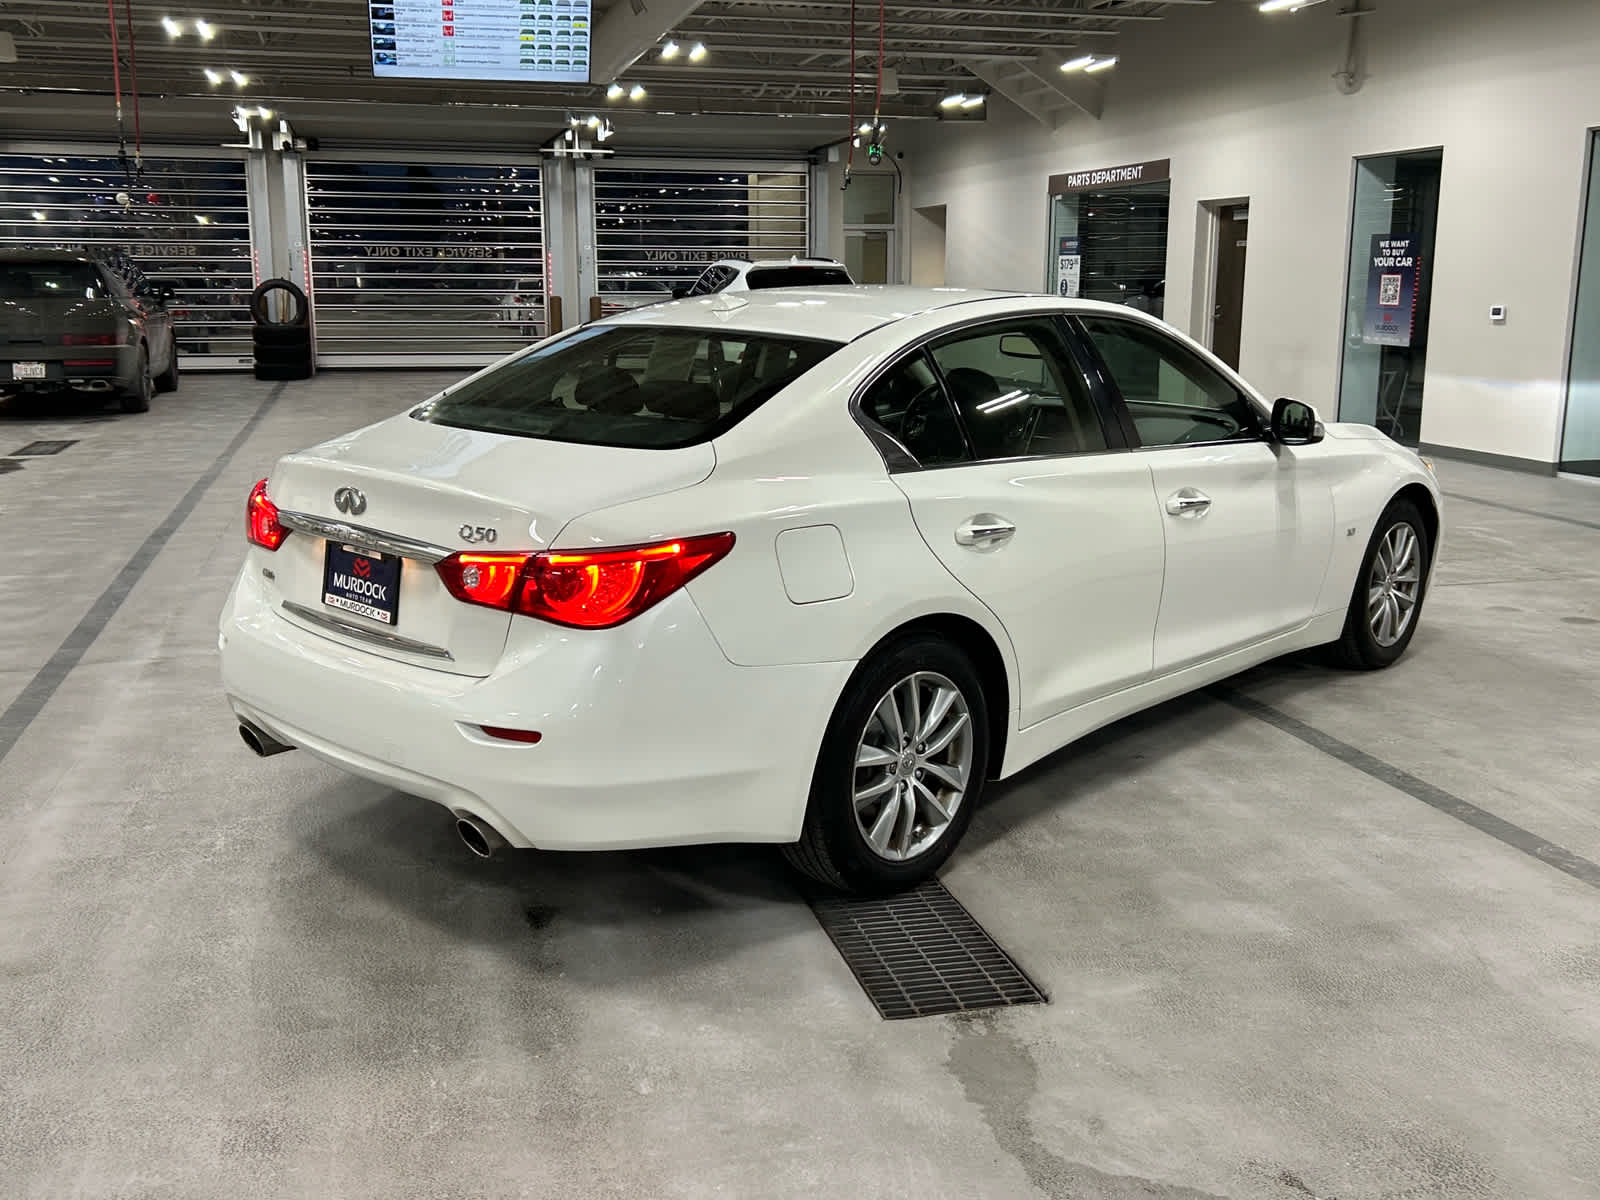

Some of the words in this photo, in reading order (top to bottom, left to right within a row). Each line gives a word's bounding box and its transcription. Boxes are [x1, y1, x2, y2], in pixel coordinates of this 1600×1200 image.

[1067, 173, 1090, 188] PARTS
[1091, 165, 1144, 185] DEPARTMENT
[1380, 240, 1390, 248] WE
[1391, 240, 1410, 248] WANT
[1373, 257, 1395, 267] YOUR
[1395, 257, 1413, 267] CAR
[459, 524, 498, 544] Q50
[333, 571, 387, 601] MURDOCK
[345, 592, 359, 601] AUTO
[340, 598, 376, 617] MURDOCK
